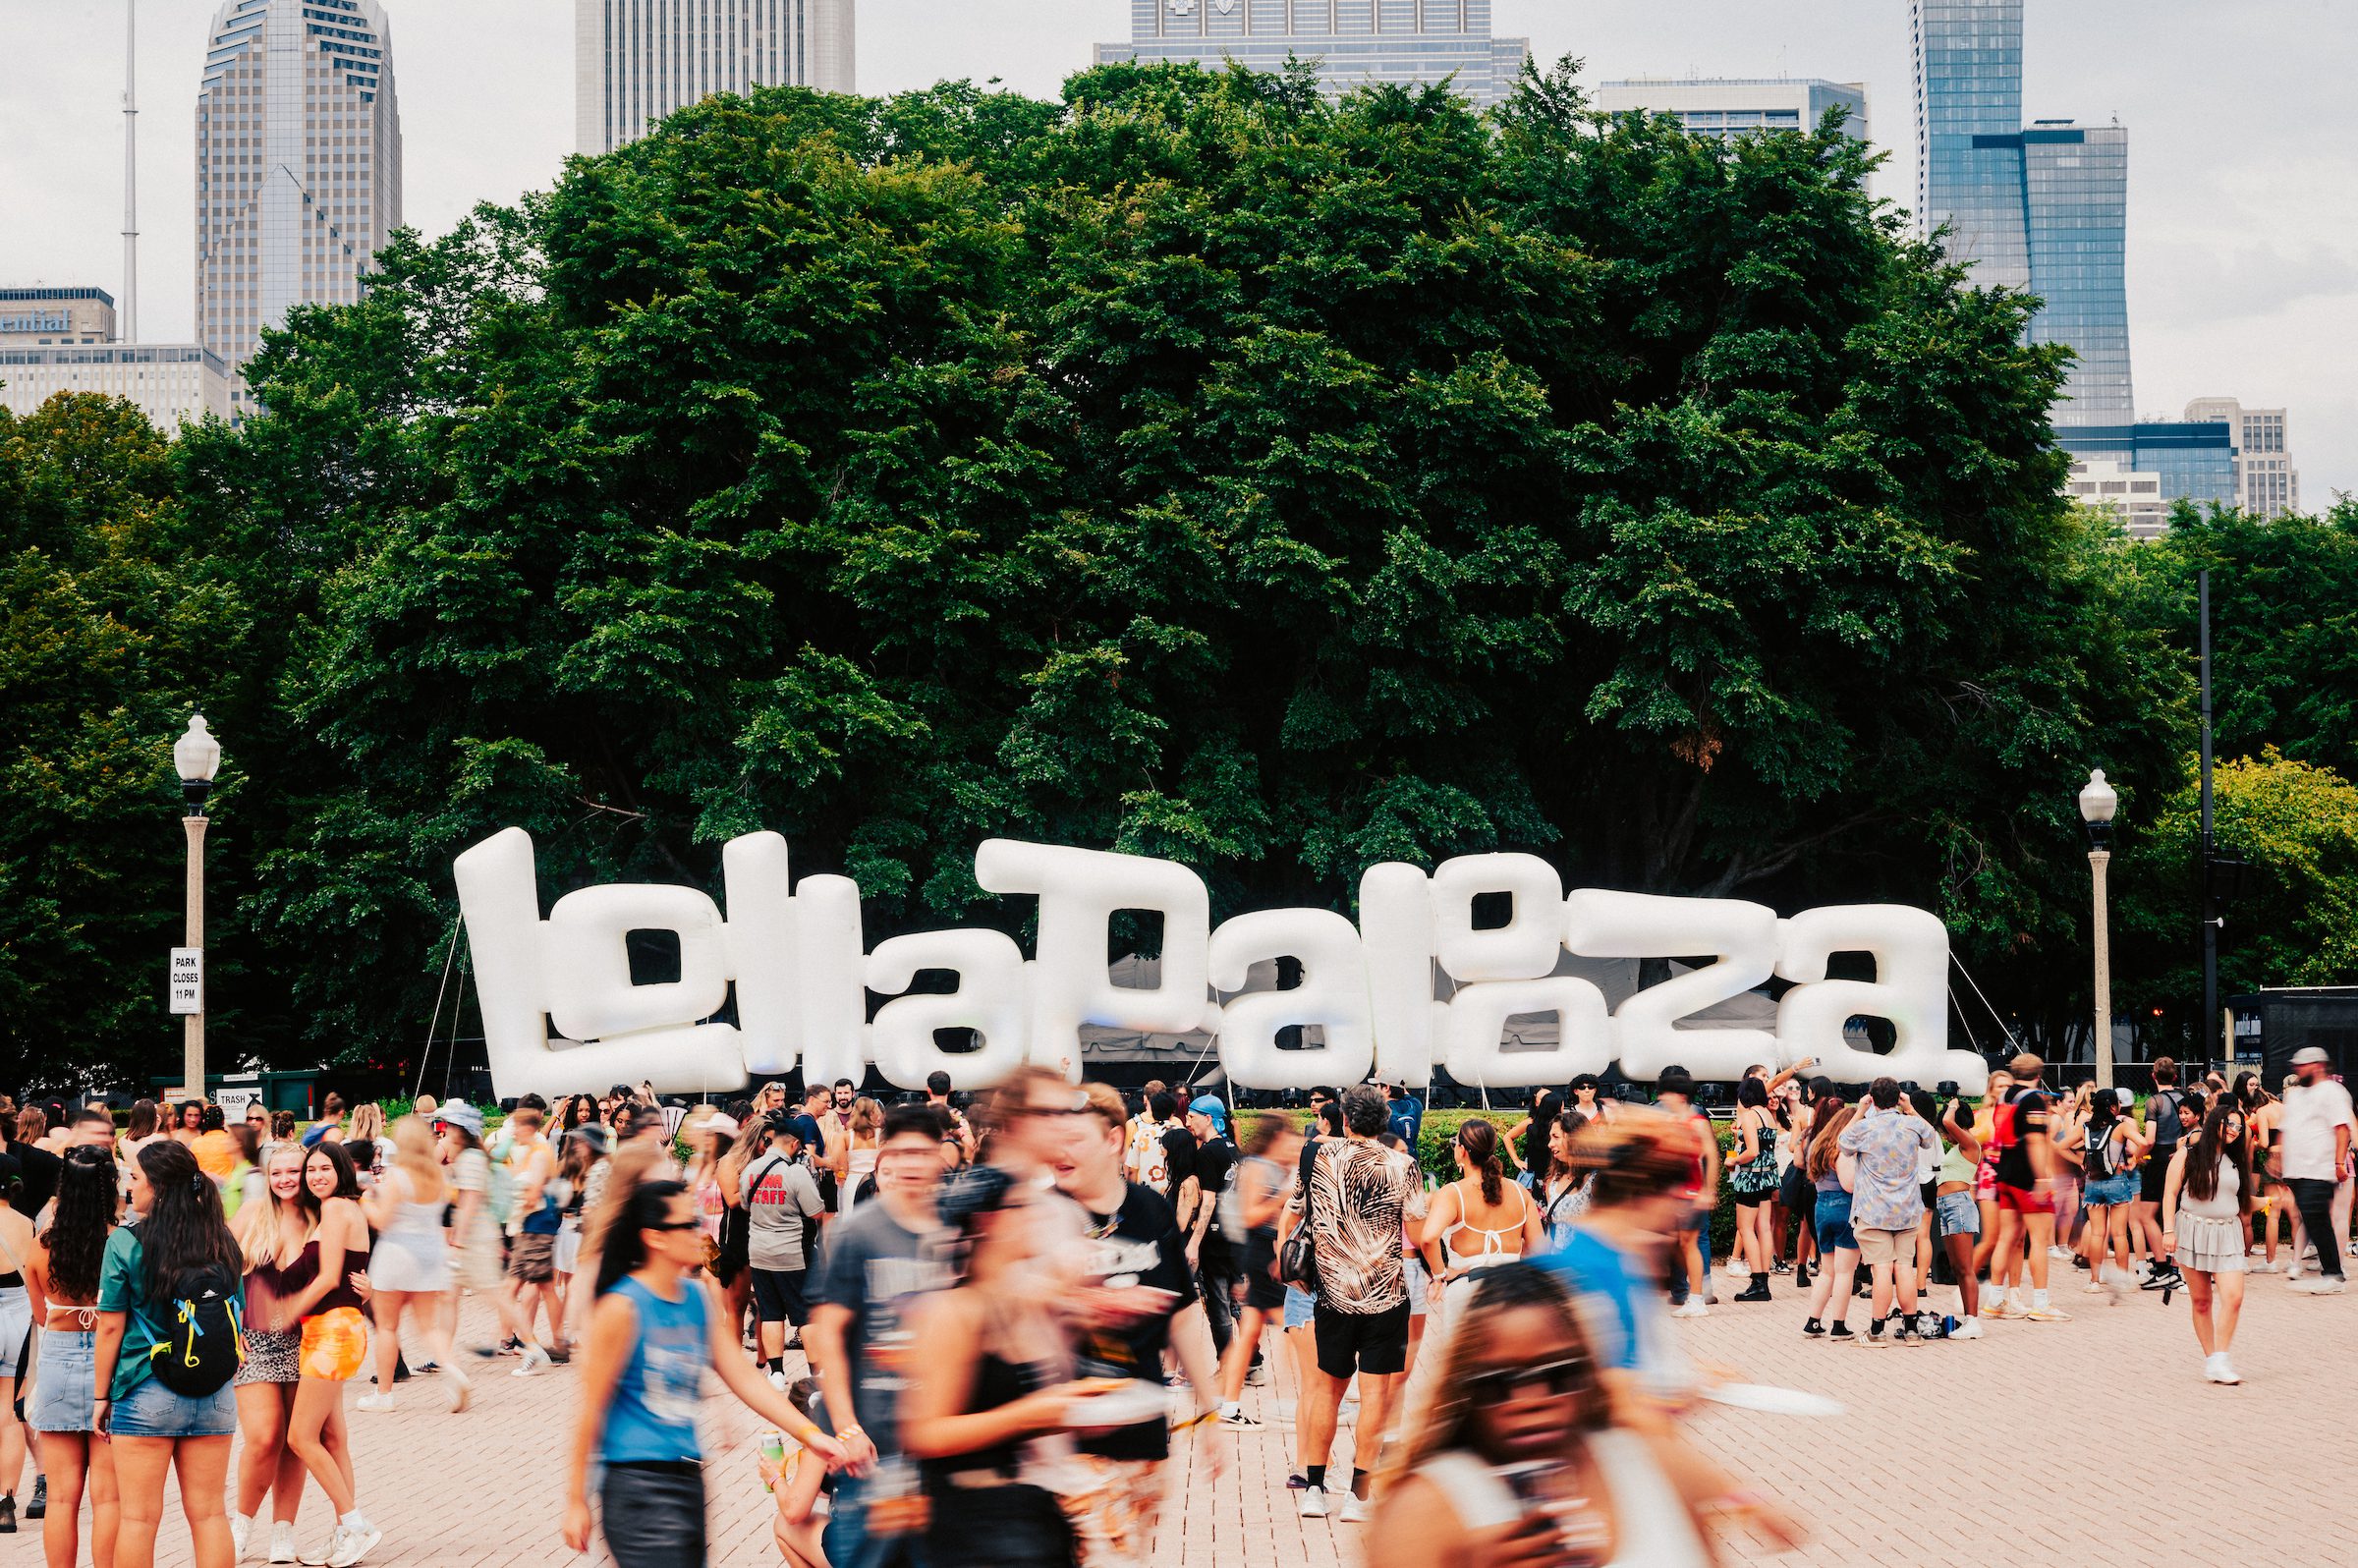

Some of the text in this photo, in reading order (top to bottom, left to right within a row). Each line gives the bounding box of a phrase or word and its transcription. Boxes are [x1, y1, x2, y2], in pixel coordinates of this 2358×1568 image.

[176, 958, 196, 967] PARK
[173, 973, 198, 983] CLOSES
[176, 989, 195, 999] 11 PM
[221, 1095, 245, 1104] TRASH
[751, 1190, 786, 1204] TAFF
